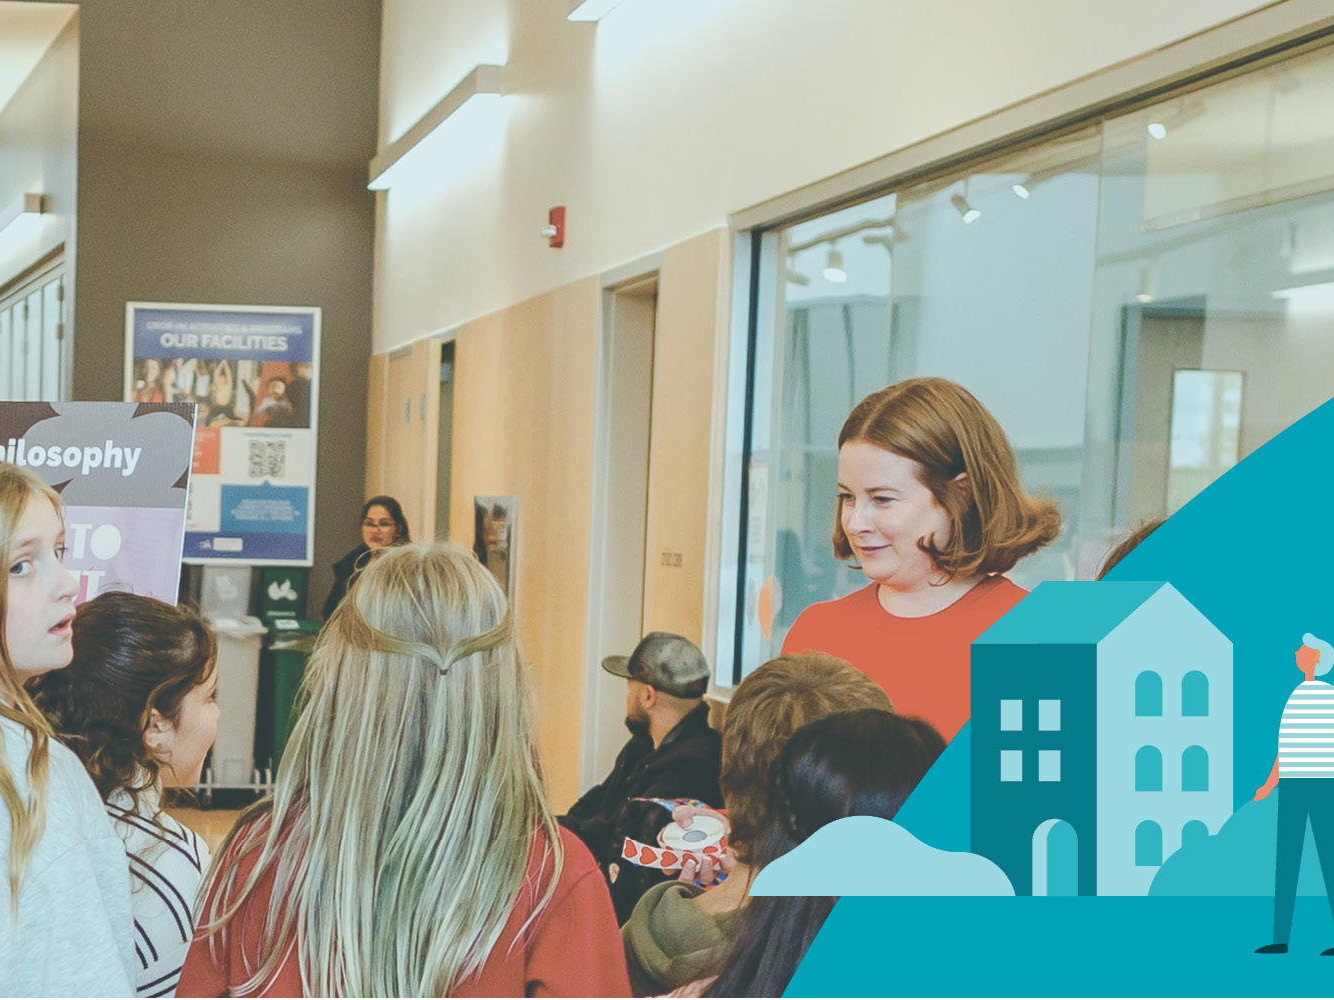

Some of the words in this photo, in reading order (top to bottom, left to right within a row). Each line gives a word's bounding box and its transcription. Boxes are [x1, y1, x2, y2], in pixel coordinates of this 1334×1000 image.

[160, 332, 198, 348] OUR
[201, 334, 288, 351] FACILITIES
[70, 523, 122, 560] TO
